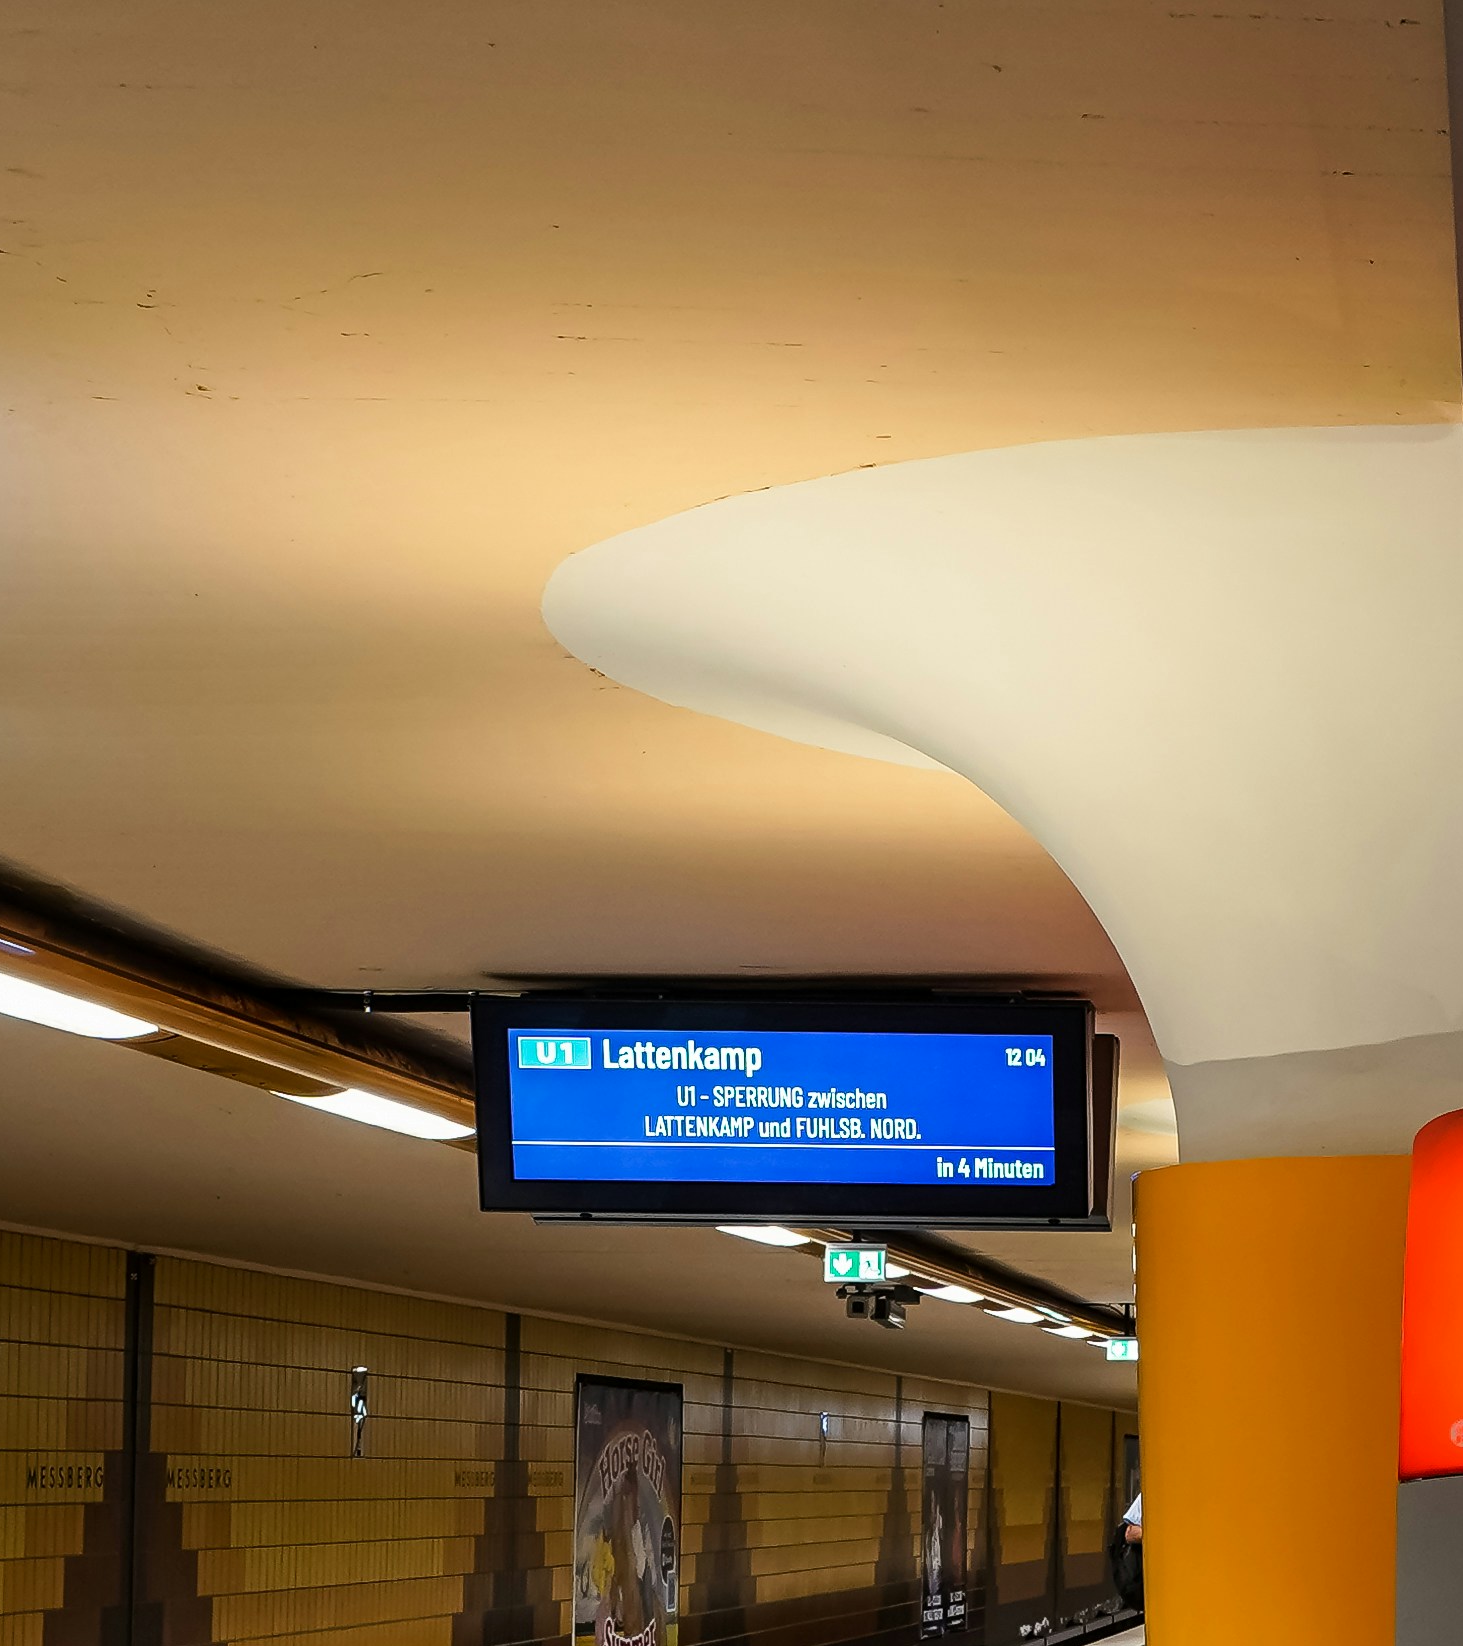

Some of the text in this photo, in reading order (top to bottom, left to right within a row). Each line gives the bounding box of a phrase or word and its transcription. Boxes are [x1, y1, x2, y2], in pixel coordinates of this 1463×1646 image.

[535, 1038, 763, 1079] U1 Lattenkamp
[676, 1085, 696, 1107] U1
[712, 1085, 804, 1109] SPERRUNG
[807, 1087, 888, 1110] zwischen
[644, 1115, 922, 1140] LATTENKAMP und FUHLSB. NORD.
[936, 1156, 1045, 1180] in 4 Minuten
[598, 1429, 667, 1500] Horse Girl
[26, 1465, 105, 1491] MESSBERG
[165, 1467, 232, 1490] MESSBERG
